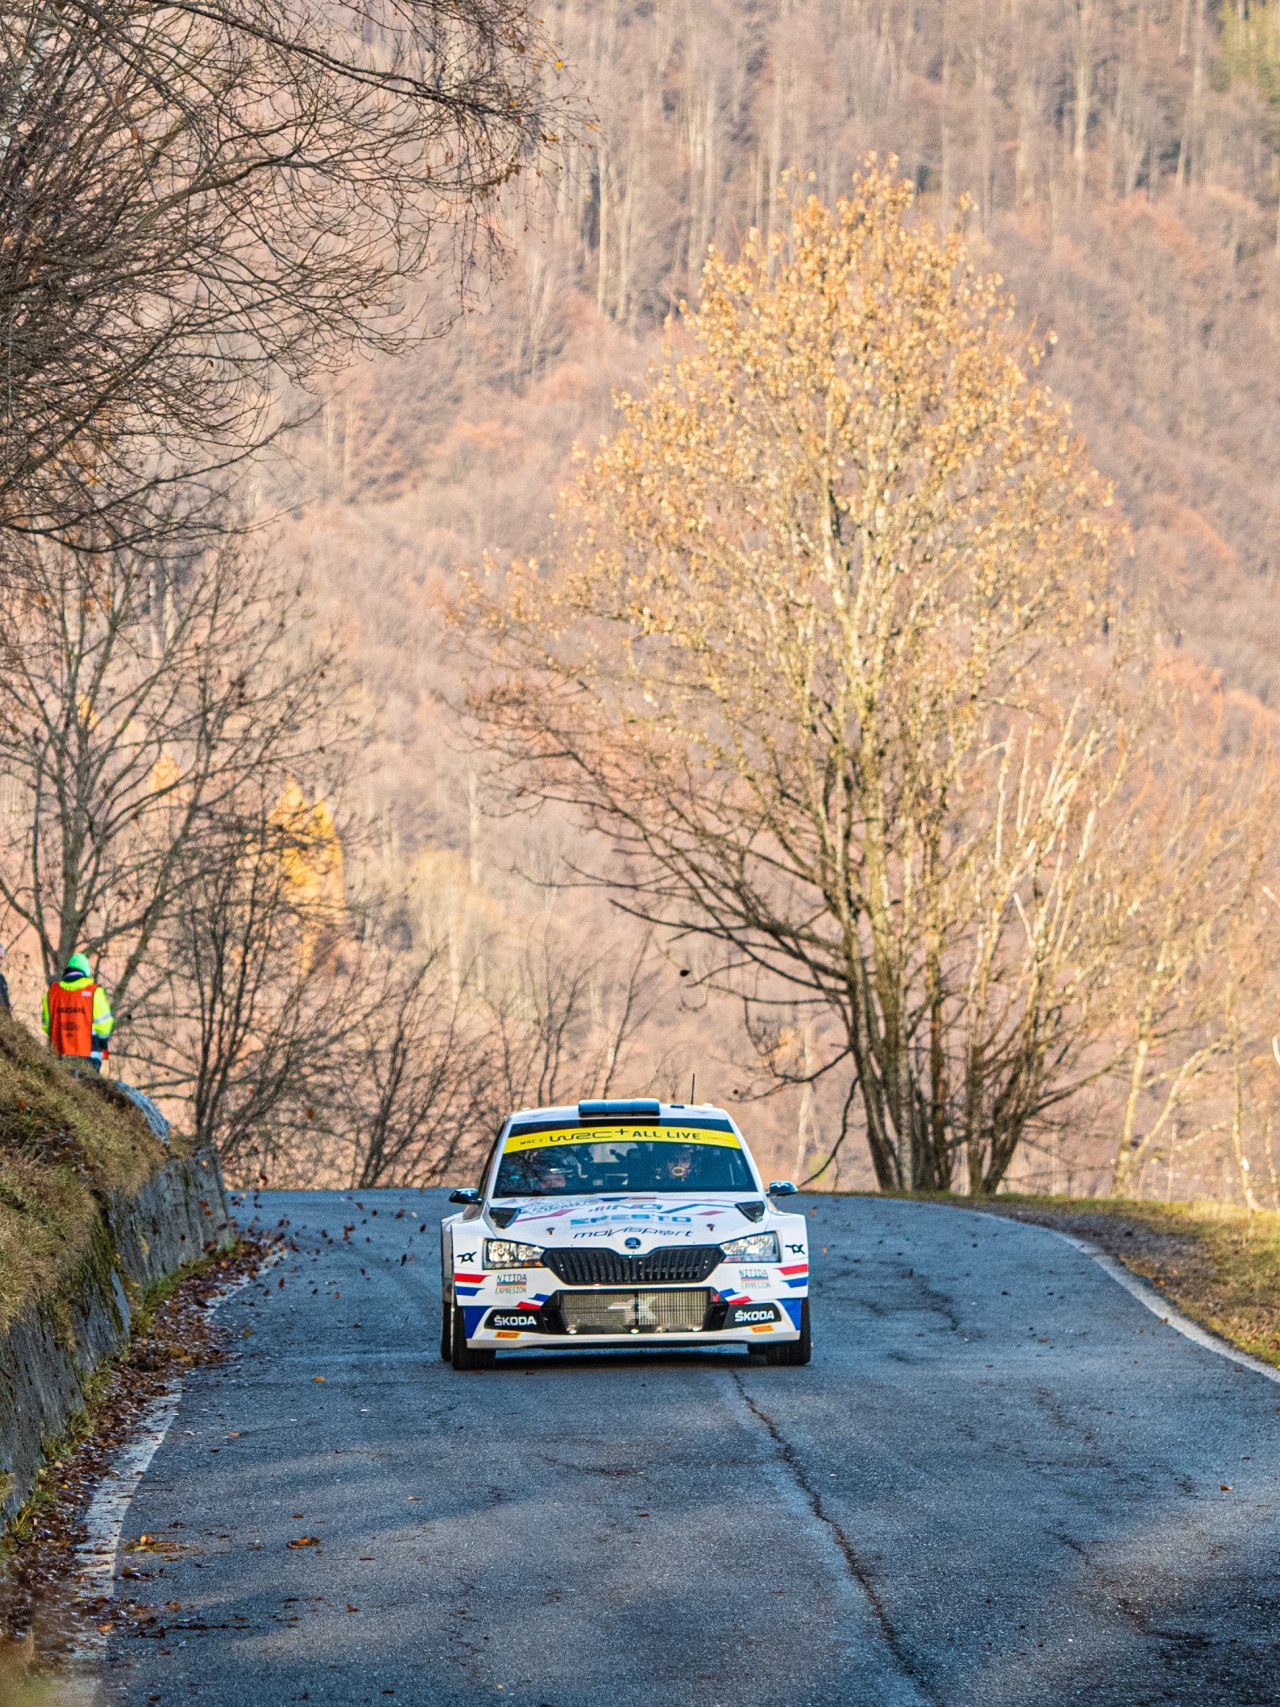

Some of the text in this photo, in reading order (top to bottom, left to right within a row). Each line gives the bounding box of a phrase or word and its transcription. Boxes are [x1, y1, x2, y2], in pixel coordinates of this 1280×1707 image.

[632, 1130, 661, 1138] ALL
[666, 1131, 701, 1140] LIVE
[496, 1273, 527, 1283] NITIDA
[493, 1314, 537, 1326] ŠKODA
[734, 1309, 775, 1322] ŠKODA
